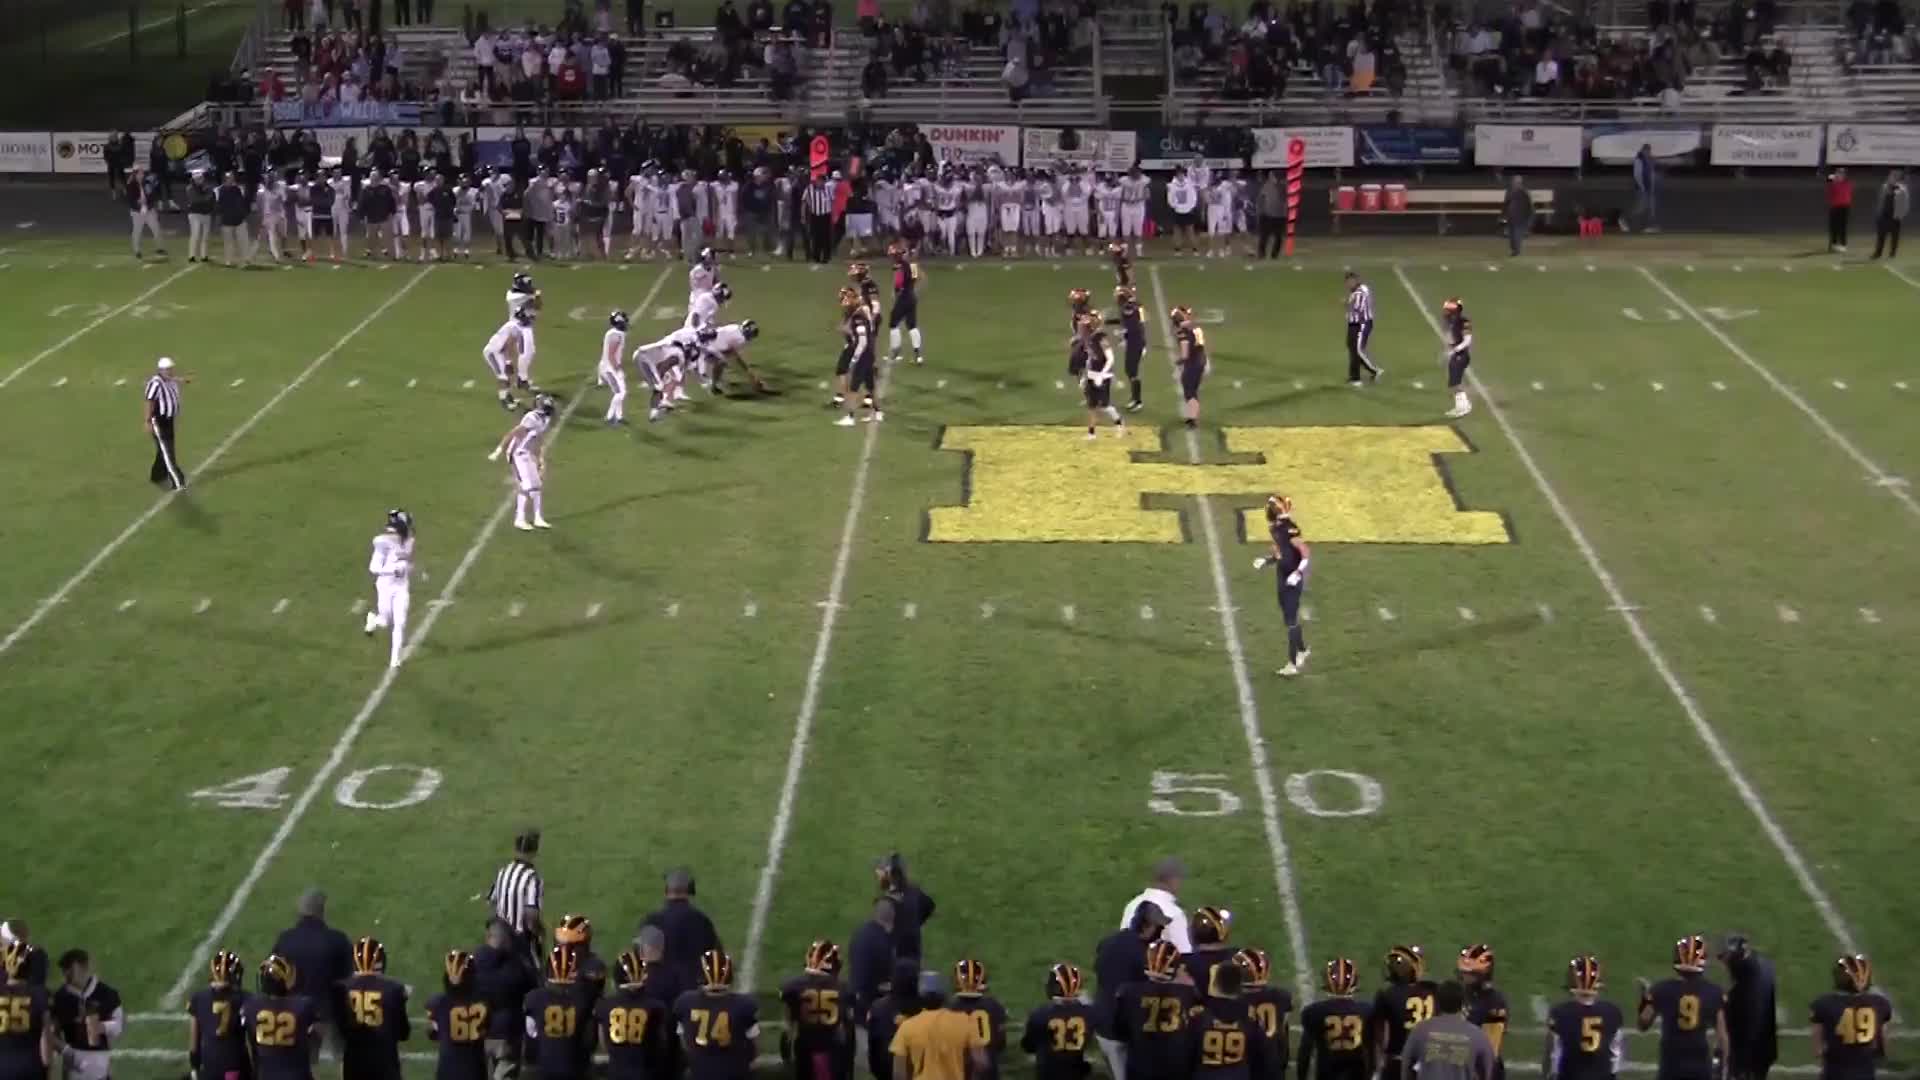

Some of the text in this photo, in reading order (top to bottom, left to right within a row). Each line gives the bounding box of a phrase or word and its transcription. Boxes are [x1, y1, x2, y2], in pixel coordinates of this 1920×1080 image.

[930, 127, 1005, 143] DUNKIN'
[189, 766, 443, 809] 40
[1148, 769, 1383, 818] 50
[212, 1000, 231, 1037] 7
[449, 1003, 487, 1041] 62
[544, 1006, 575, 1038] 81
[804, 990, 839, 1025] 25
[1141, 997, 1181, 1033] 73
[1404, 995, 1434, 1029] 31
[1678, 995, 1698, 1029] 9
[256, 1007, 297, 1047] 22
[609, 1007, 648, 1045] 88
[690, 1008, 731, 1046] 74
[1048, 1016, 1087, 1051] 33
[1324, 1014, 1362, 1051] 23
[1580, 1015, 1600, 1052] 5
[1836, 1008, 1876, 1044] 49
[1201, 1031, 1245, 1065] 99
